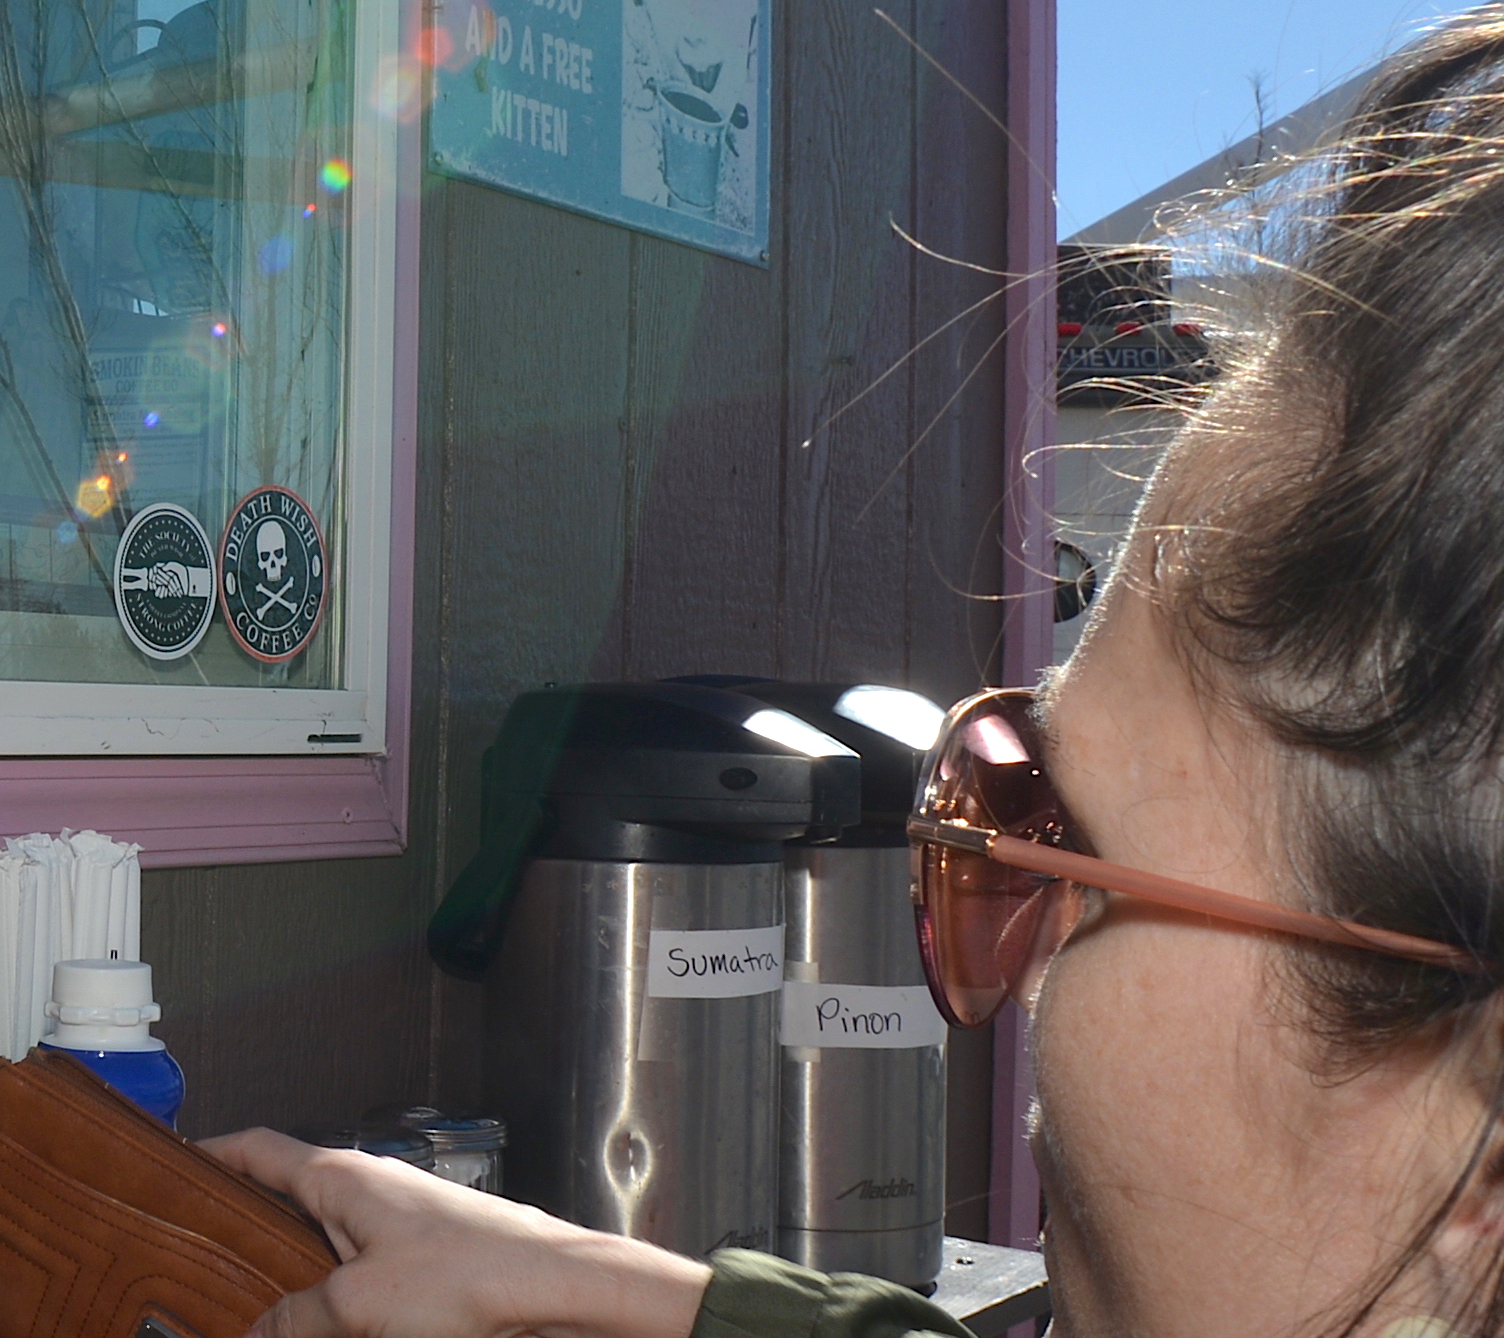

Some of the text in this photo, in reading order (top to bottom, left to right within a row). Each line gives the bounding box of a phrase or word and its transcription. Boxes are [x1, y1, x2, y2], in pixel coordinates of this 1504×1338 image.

[465, 4, 593, 95] AND A FREE
[491, 86, 568, 157] KITTEN
[225, 494, 318, 563] DEATH WISH
[236, 611, 304, 654] COFFEE
[667, 945, 780, 978] Sumatra
[815, 997, 902, 1035] Pinon
[836, 1177, 917, 1202] Aladdin
